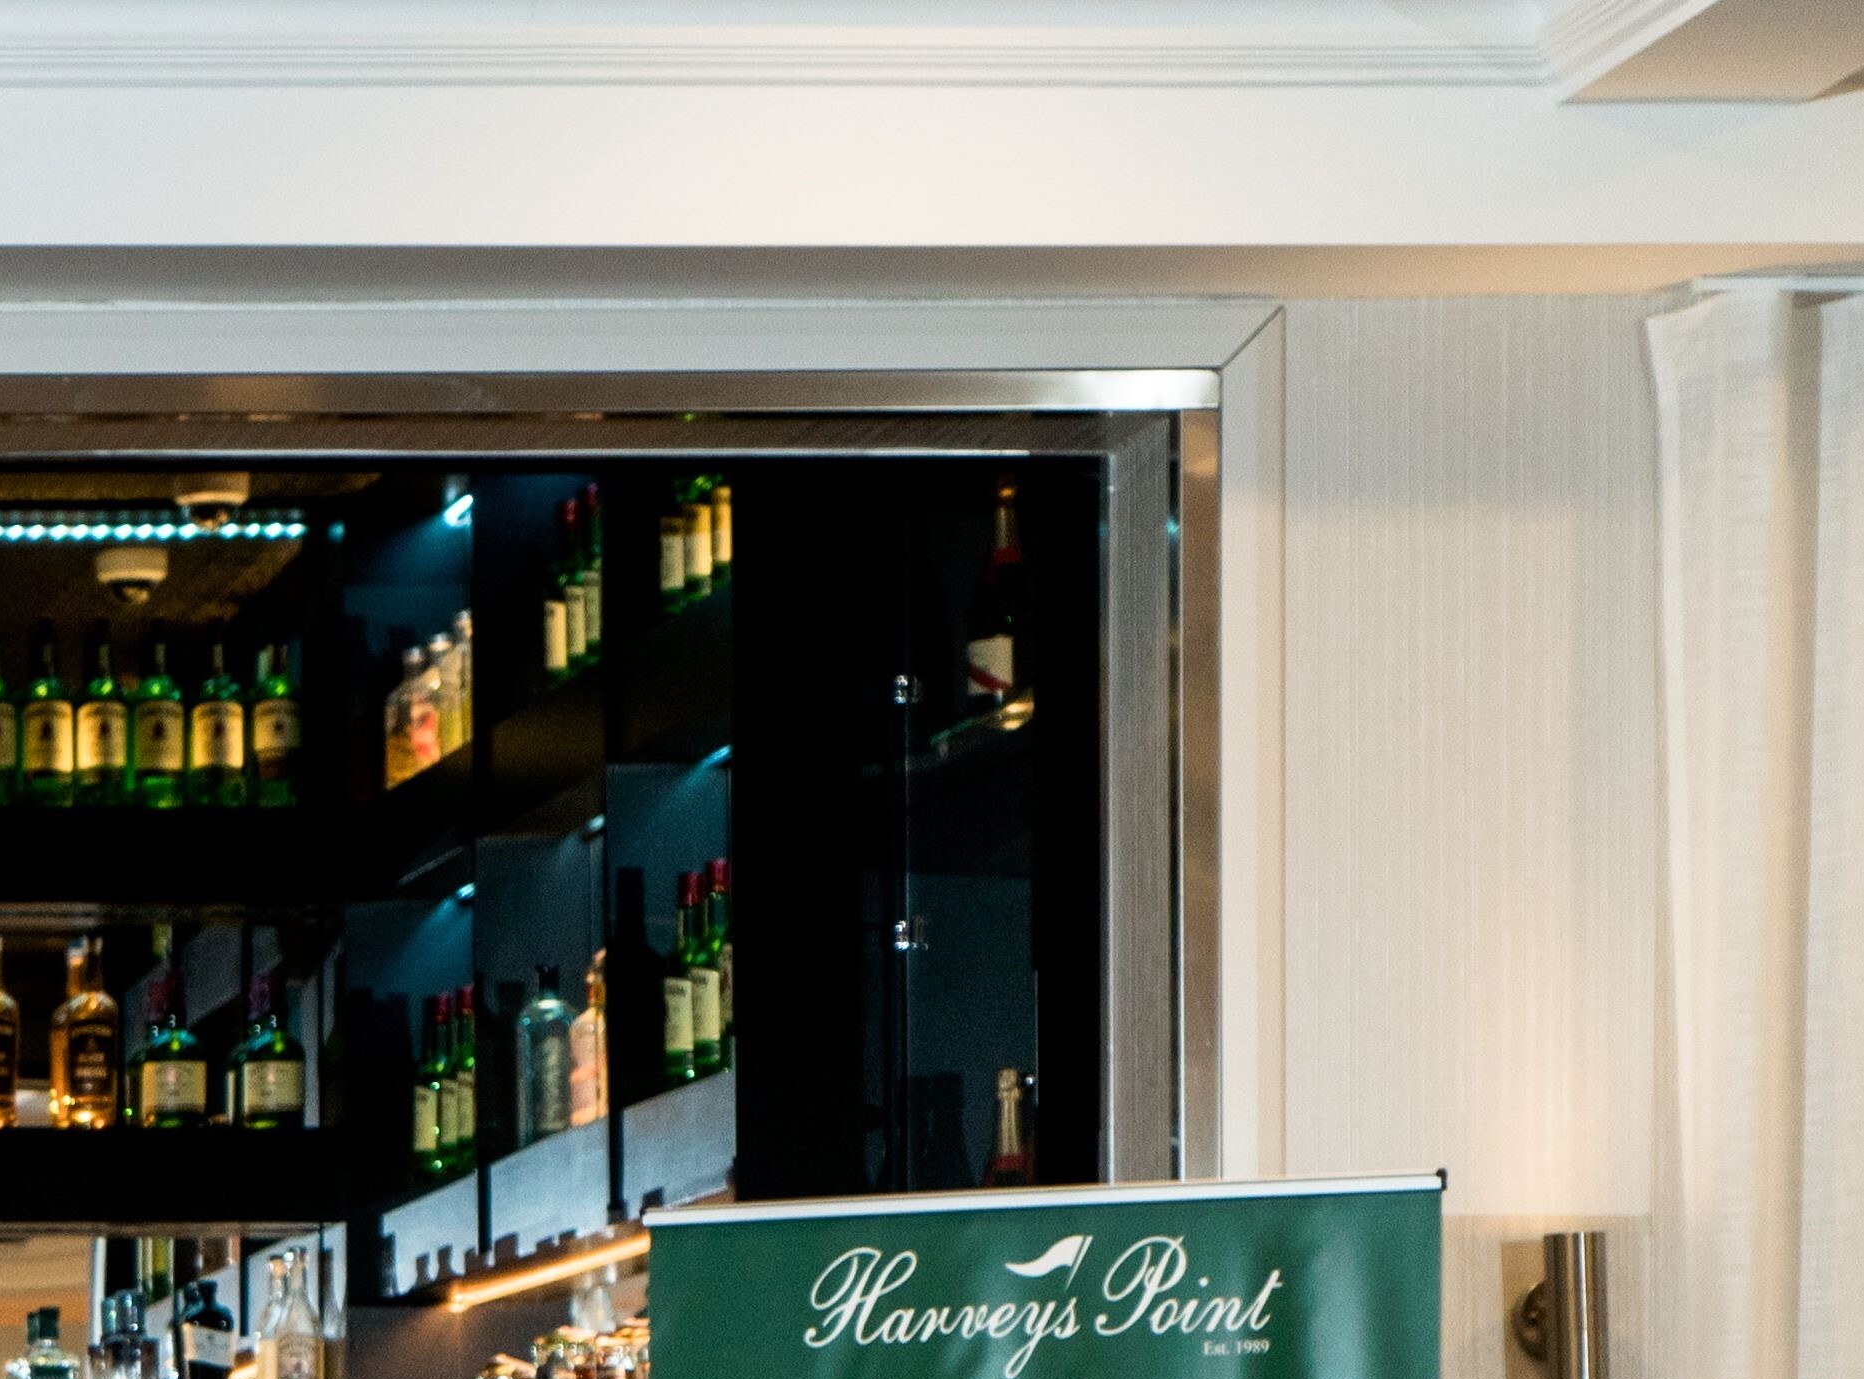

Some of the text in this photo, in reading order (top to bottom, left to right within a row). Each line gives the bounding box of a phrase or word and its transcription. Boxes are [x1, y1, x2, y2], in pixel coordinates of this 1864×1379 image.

[1094, 1236, 1282, 1336] Point
[1203, 1339, 1270, 1356] Est. 1989
